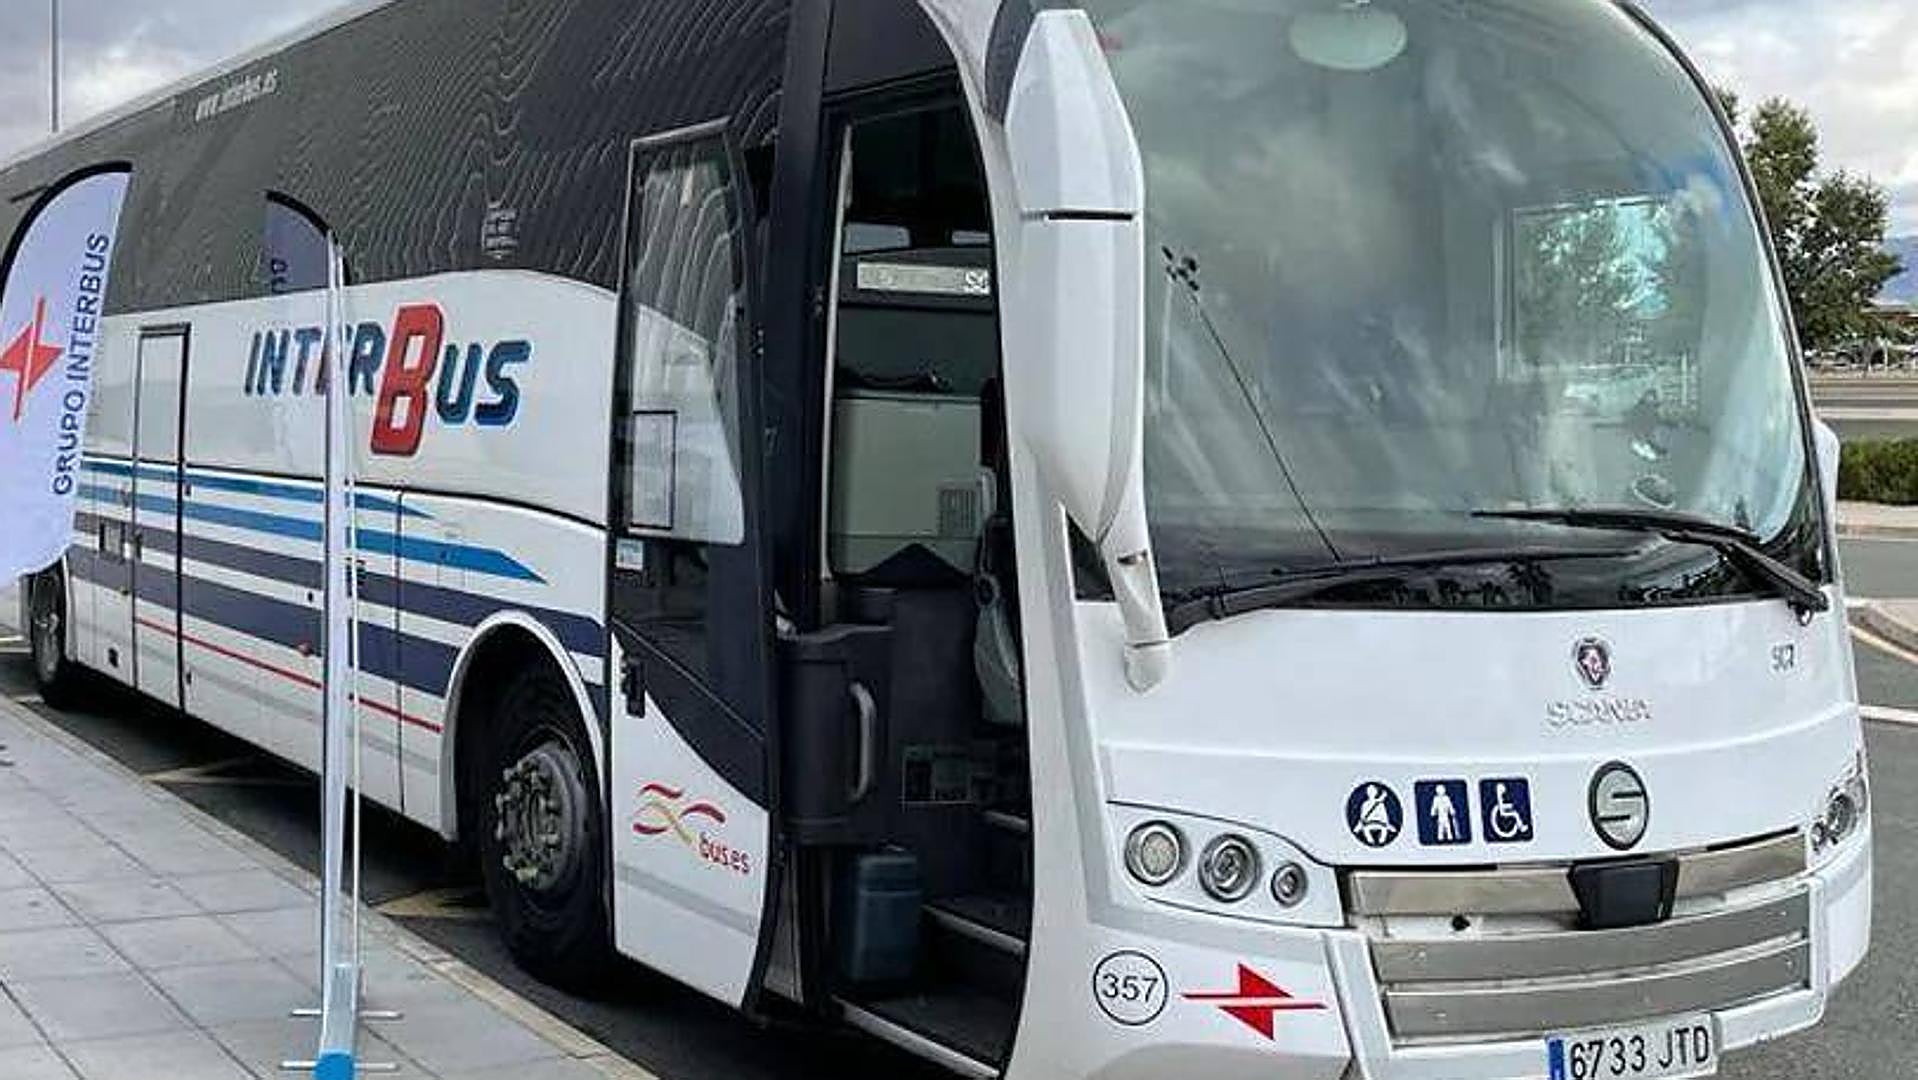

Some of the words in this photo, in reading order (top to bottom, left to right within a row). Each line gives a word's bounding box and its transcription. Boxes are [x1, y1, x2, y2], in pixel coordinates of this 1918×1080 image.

[66, 232, 110, 381] INTERBUS
[52, 388, 86, 495] GRUPO
[1102, 972, 1158, 1003] 357
[1570, 1034, 1646, 1080] 6733
[1657, 1024, 1709, 1068] JTD
